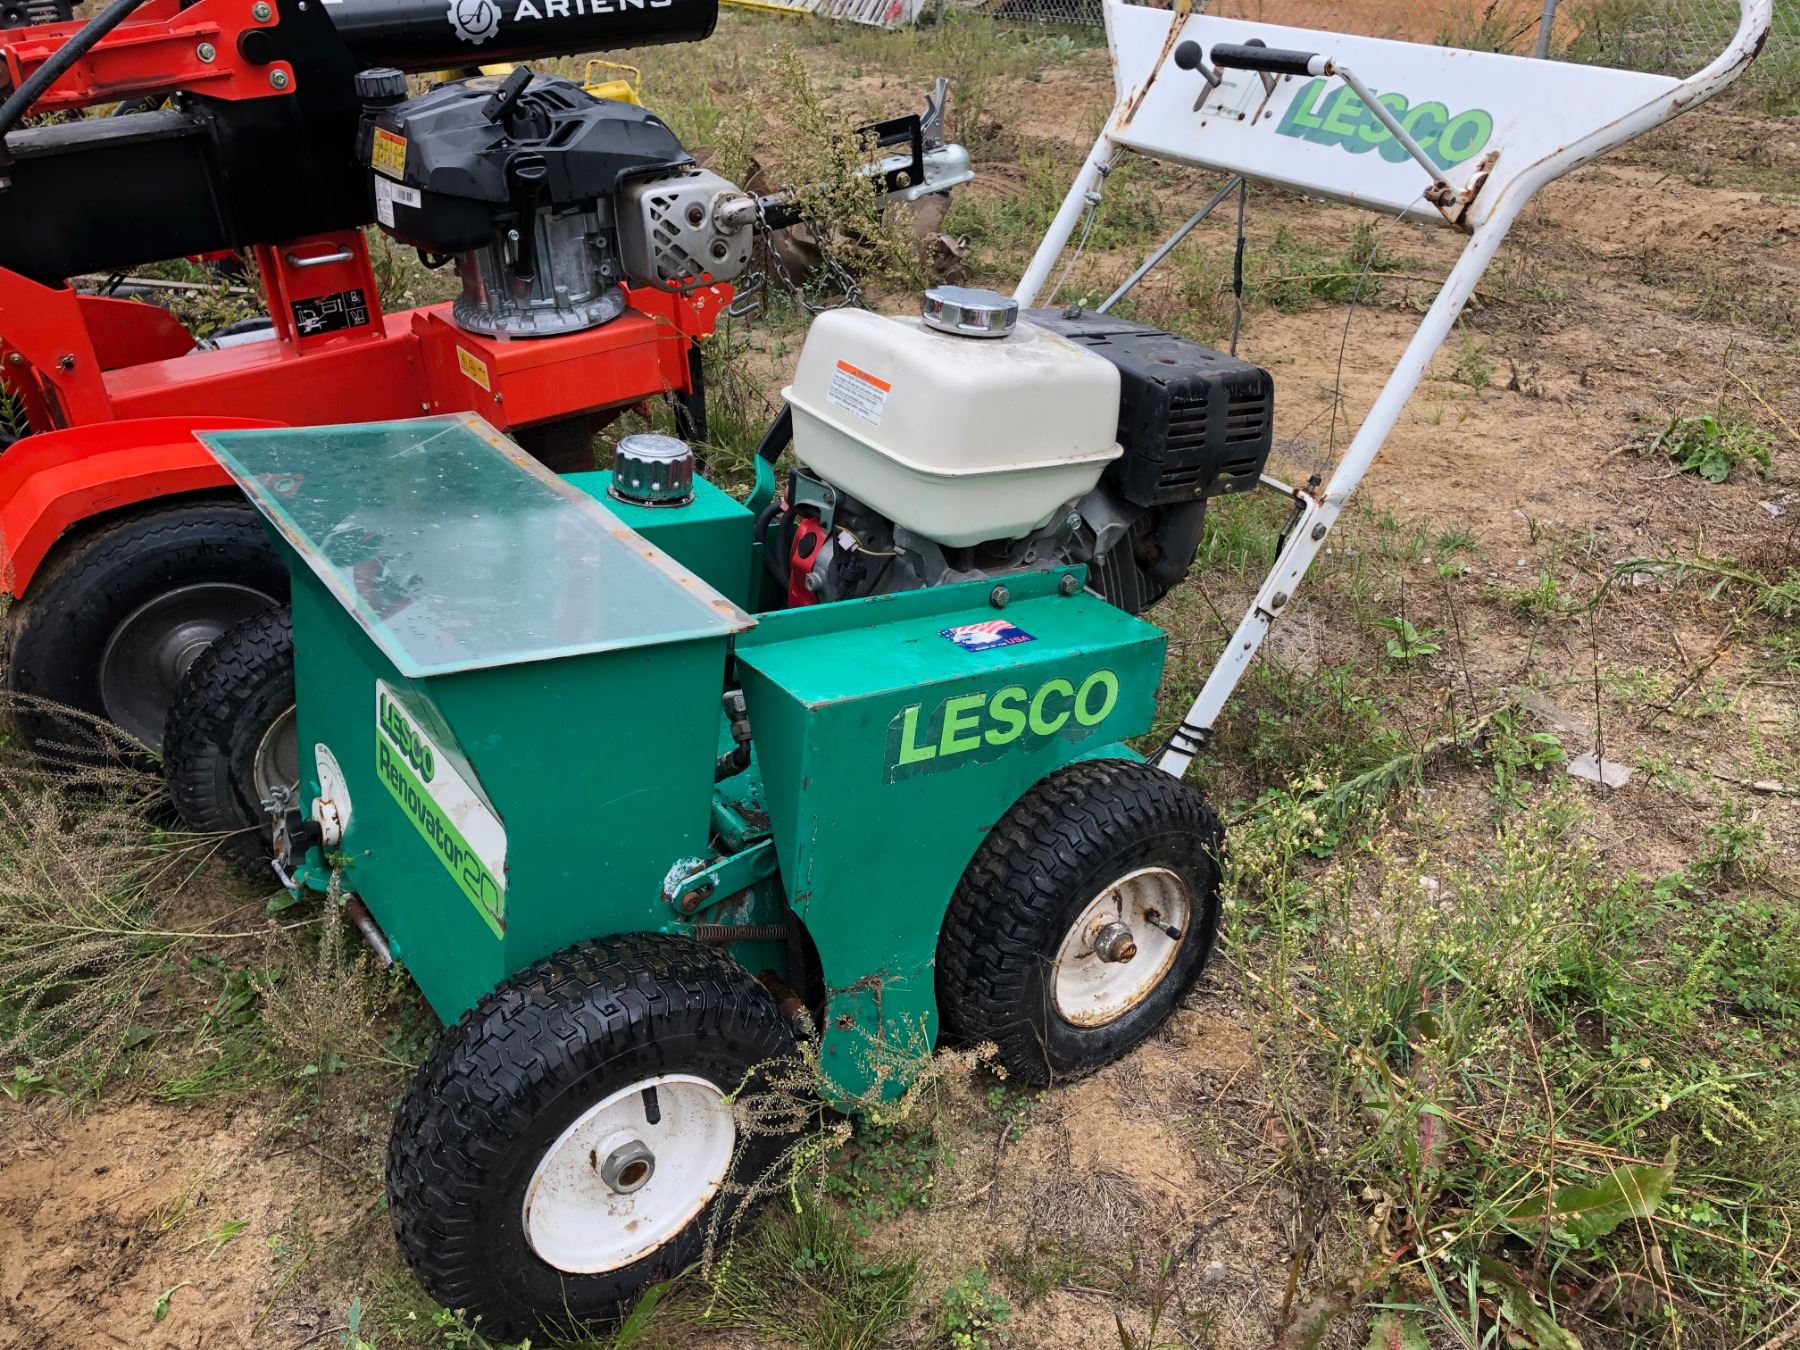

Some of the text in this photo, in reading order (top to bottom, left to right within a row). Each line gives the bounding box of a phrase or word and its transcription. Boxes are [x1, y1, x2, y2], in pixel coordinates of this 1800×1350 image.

[1291, 78, 1494, 163] LESCO
[1005, 635, 1031, 645] USA
[380, 692, 435, 784] LESCO
[899, 669, 1119, 766] LESCO
[380, 739, 463, 870] Renovator
